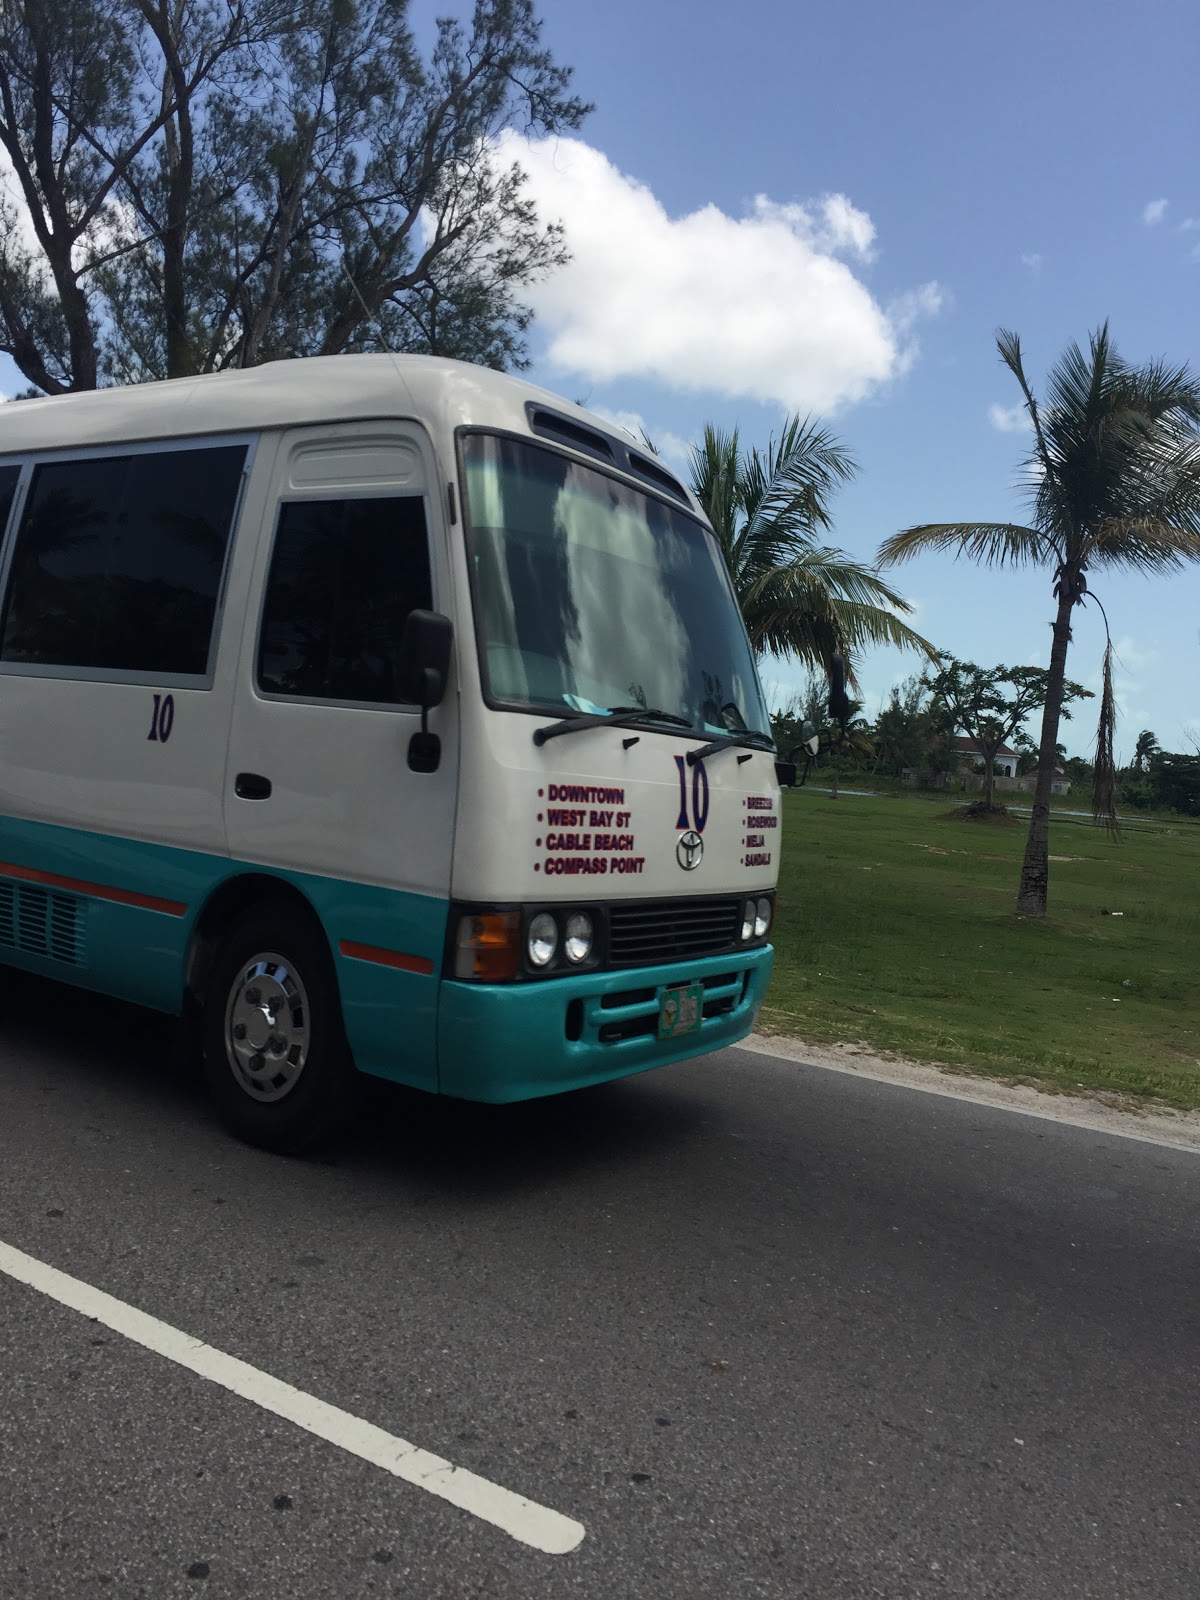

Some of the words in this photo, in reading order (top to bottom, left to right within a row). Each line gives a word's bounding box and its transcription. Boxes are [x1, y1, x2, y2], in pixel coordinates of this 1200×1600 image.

[147, 694, 175, 743] 10
[548, 784, 624, 805] DOWNTOWN
[673, 755, 709, 835] 10
[547, 808, 587, 827] WEST
[589, 810, 614, 828] BAY
[616, 811, 631, 828] ST
[546, 833, 592, 851] CABLE
[594, 833, 634, 851] BEACH
[544, 857, 608, 875] COMPASS
[610, 857, 645, 874] POINT
